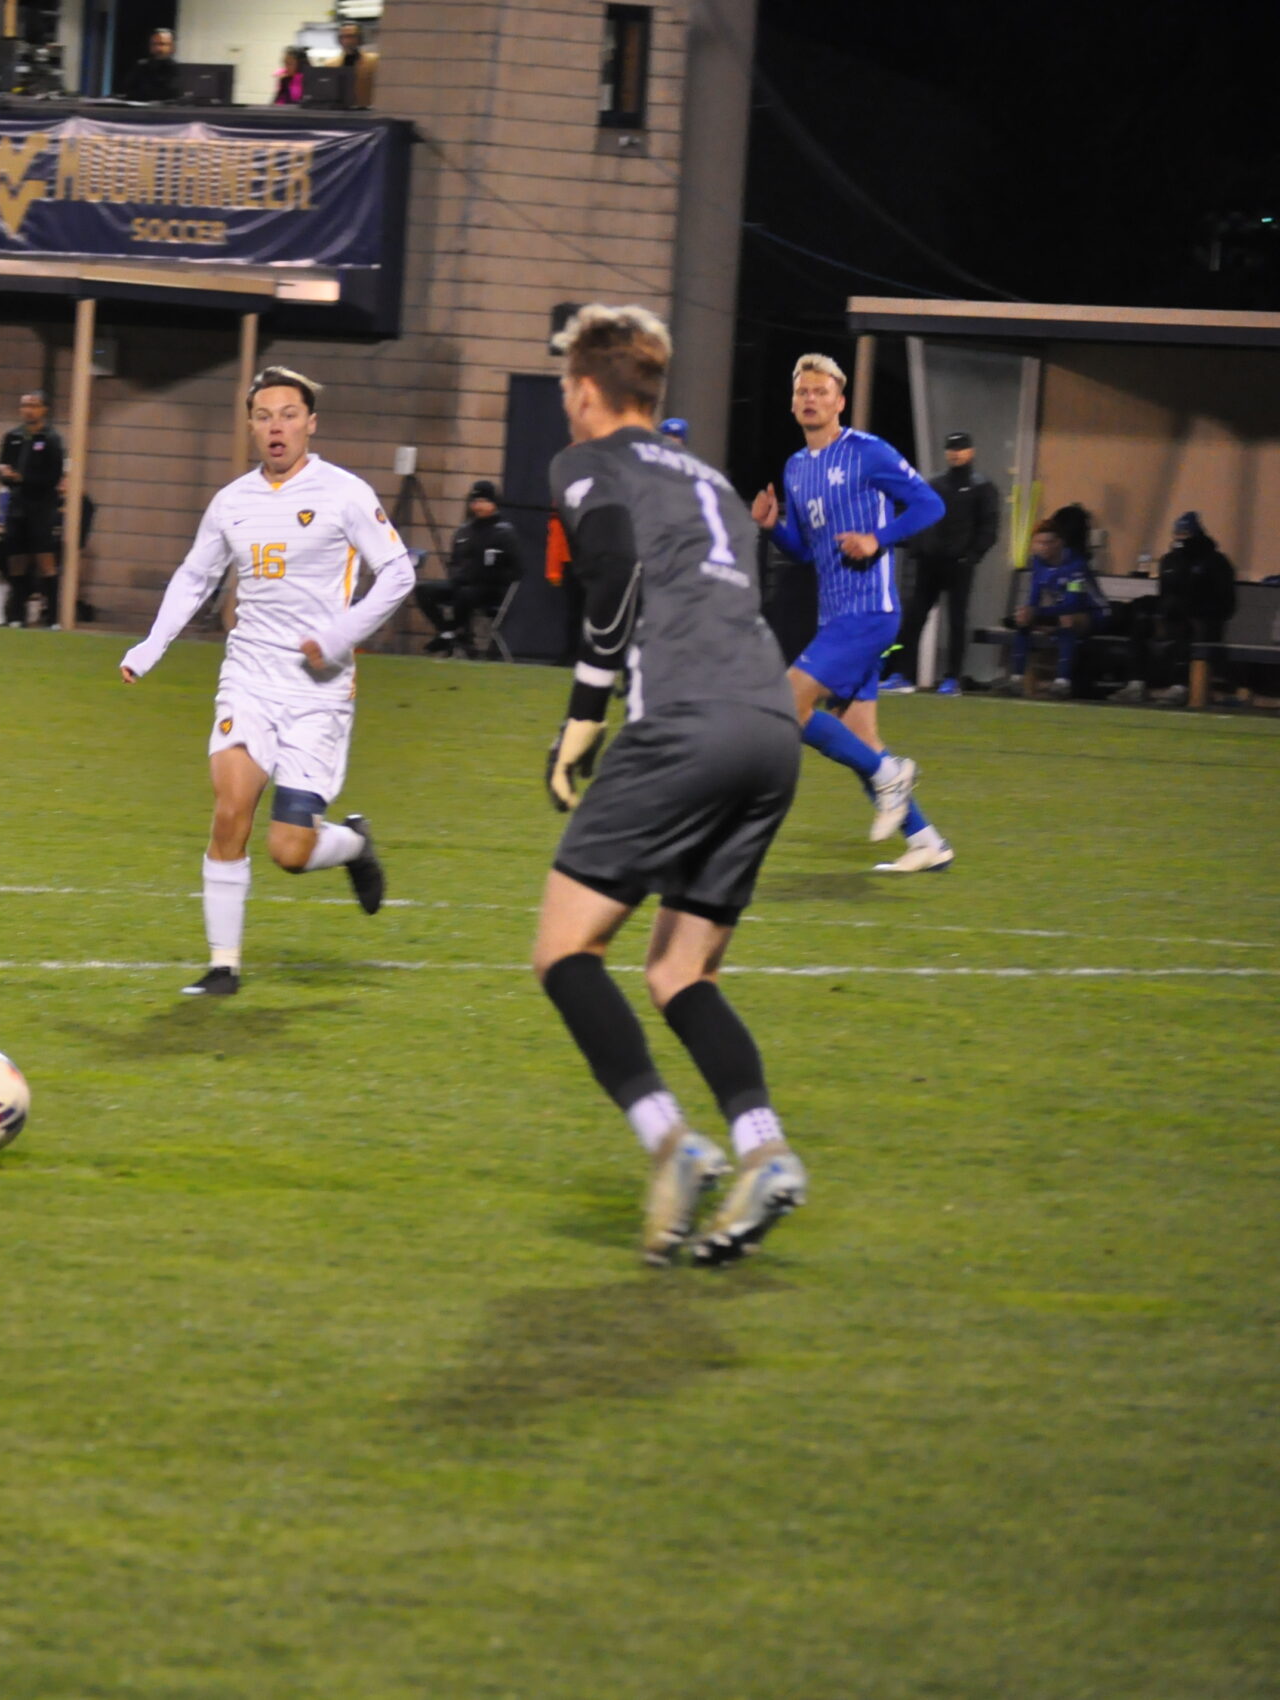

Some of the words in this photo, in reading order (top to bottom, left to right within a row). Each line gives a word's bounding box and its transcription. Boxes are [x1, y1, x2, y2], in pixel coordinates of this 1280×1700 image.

[131, 217, 228, 245] SOCCER
[695, 480, 736, 564] 1
[807, 496, 825, 529] 21
[251, 542, 287, 580] 16
